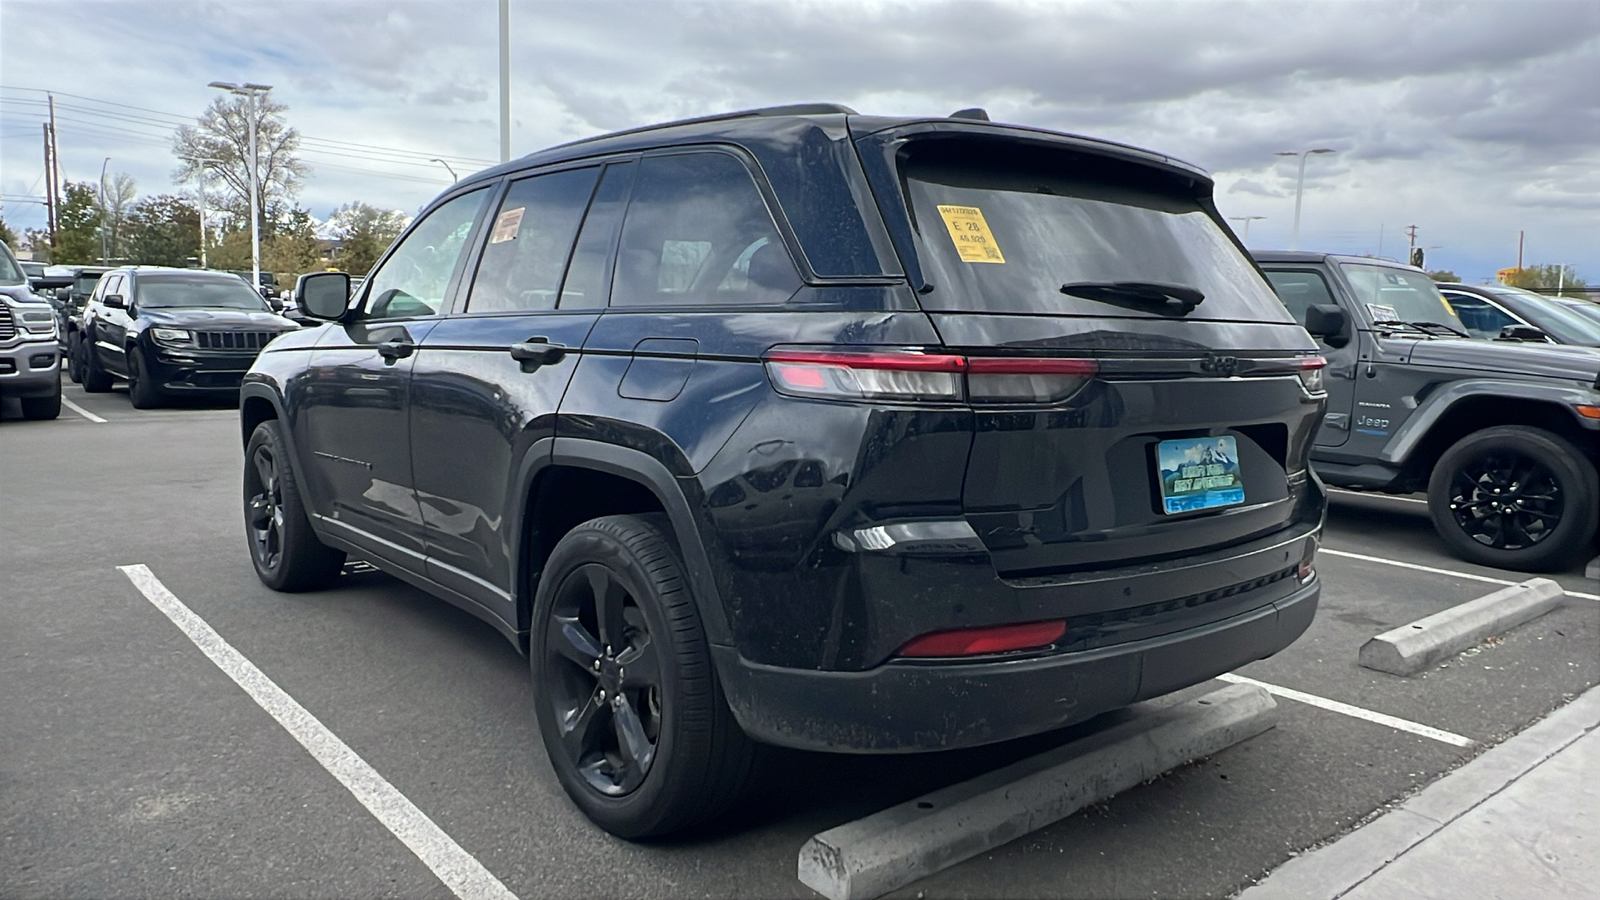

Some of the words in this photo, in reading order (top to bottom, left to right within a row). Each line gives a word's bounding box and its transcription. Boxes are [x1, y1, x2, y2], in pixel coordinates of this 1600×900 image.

[953, 222, 961, 231] E
[966, 222, 980, 232] 28
[1357, 415, 1390, 428] Jeep
